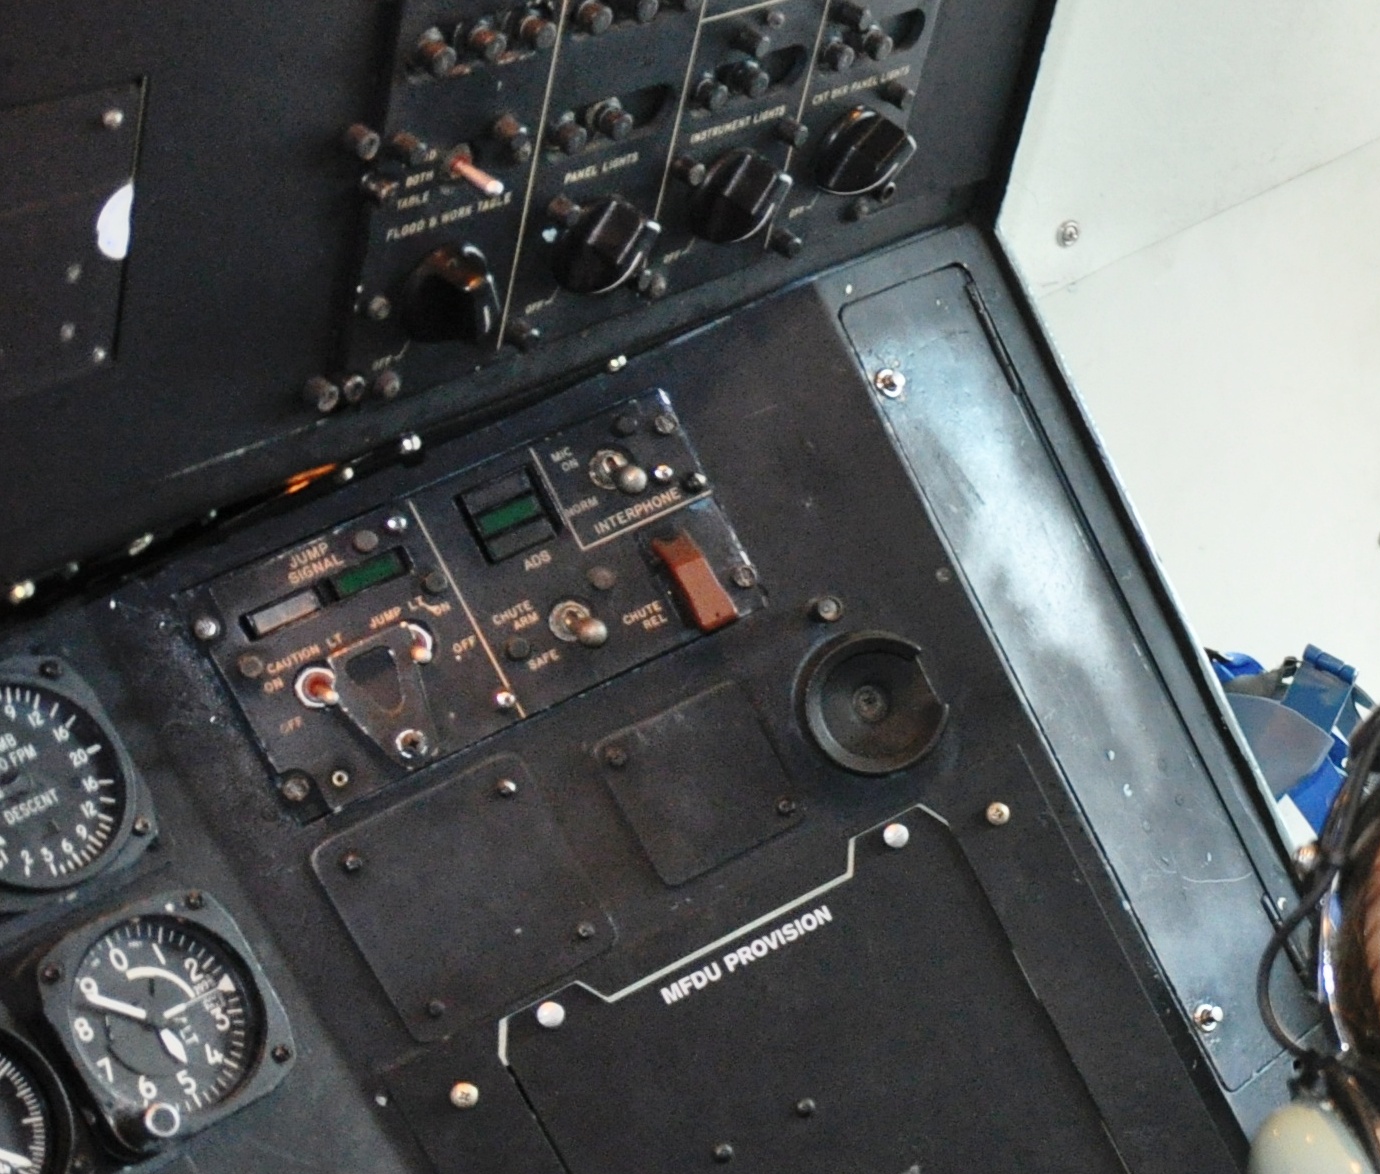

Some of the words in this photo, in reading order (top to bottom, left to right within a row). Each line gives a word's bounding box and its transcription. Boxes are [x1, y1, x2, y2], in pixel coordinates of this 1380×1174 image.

[689, 115, 752, 145] INSTRUMENT
[753, 103, 786, 125] LIGHTS
[405, 170, 435, 188] BOTH
[563, 164, 598, 186] PANEL
[601, 151, 639, 173] LIGHTS
[386, 217, 426, 242] FLOOD
[550, 446, 573, 463] MIC
[561, 458, 580, 472] ON
[593, 487, 682, 535] INTERPHONE
[290, 541, 329, 569] JUMP
[523, 550, 552, 571] ADS
[287, 554, 345, 585] SIGNAL
[369, 606, 402, 630] JUMP
[492, 600, 534, 626] CHUTE
[513, 612, 540, 631] ARM
[622, 600, 663, 626] CHUTE
[643, 613, 668, 632] REL
[266, 644, 321, 675] CAUTION
[325, 632, 343, 648] LT
[452, 634, 476, 653] OFF
[527, 649, 560, 671] SAFE
[263, 676, 285, 695] ON
[27, 710, 45, 729] 12
[52, 725, 70, 742] 16
[9, 744, 37, 767] FPM
[69, 750, 89, 768] 20
[81, 775, 99, 793] 16
[4, 788, 59, 826] DESCENT
[80, 800, 98, 819] 12
[75, 824, 88, 840] 9
[61, 838, 74, 854] 6
[109, 948, 129, 972] 0
[659, 961, 723, 1005] MFDU
[723, 905, 834, 973] PROVISION
[184, 957, 204, 983] 2
[74, 1017, 94, 1042] 8
[210, 1006, 231, 1032] 3
[205, 1043, 225, 1066] 4
[96, 1056, 114, 1083] 7
[138, 1075, 158, 1100] 6
[176, 1070, 197, 1095] 5
